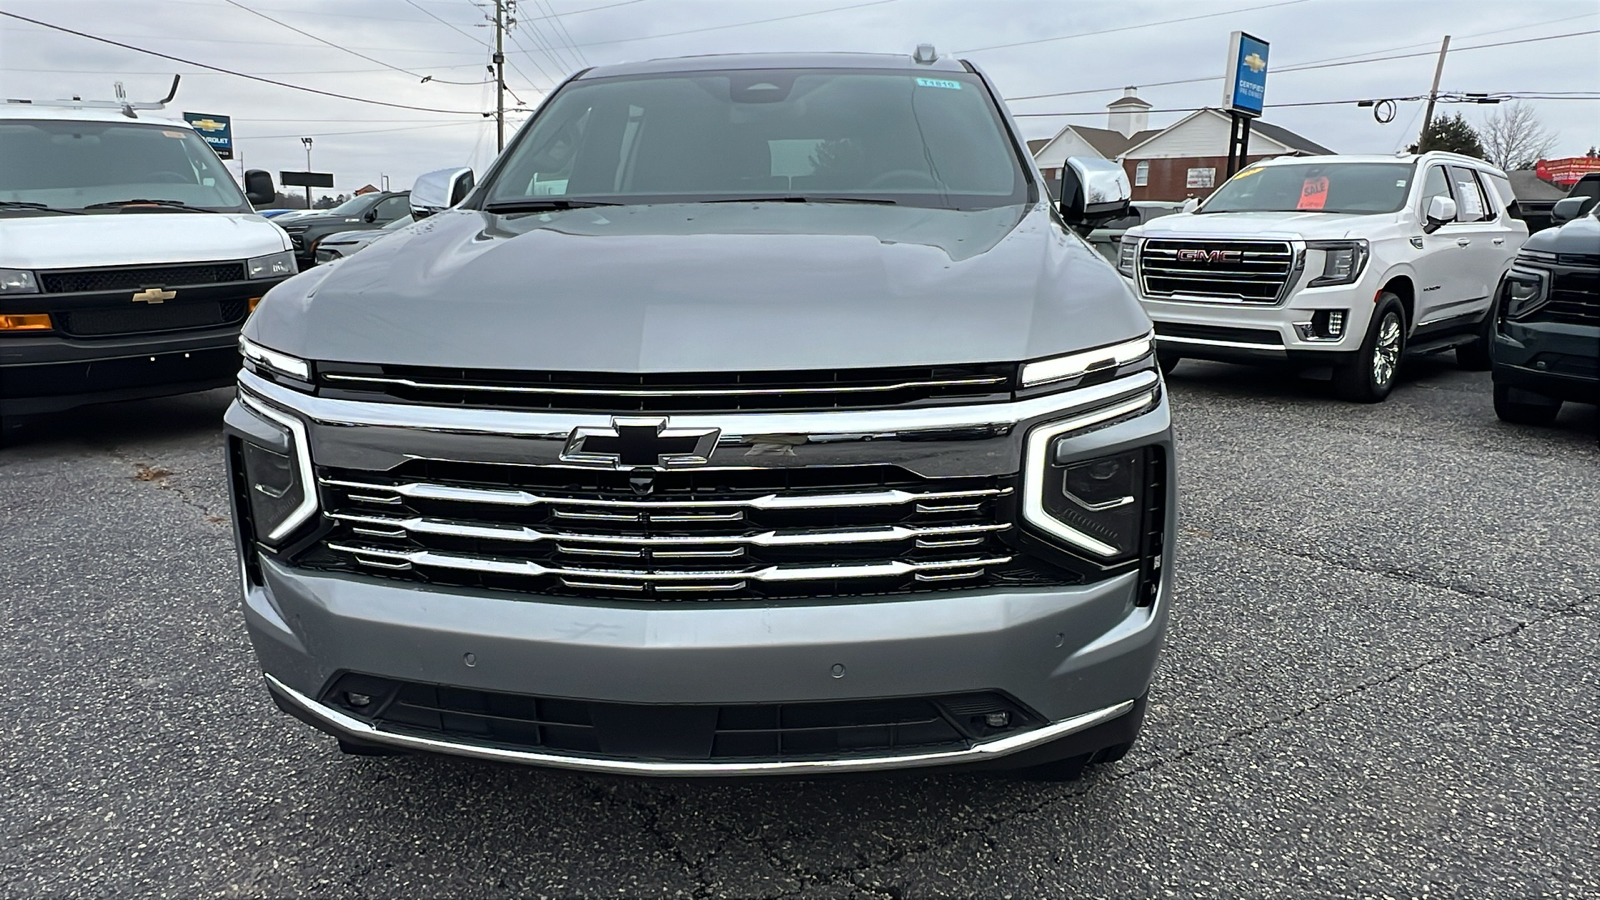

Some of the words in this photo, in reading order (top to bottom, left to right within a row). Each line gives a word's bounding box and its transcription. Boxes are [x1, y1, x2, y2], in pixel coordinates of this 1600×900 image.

[1239, 80, 1264, 93] CERTIFIED
[1304, 182, 1326, 197] SALE
[1178, 249, 1242, 263] GMC
